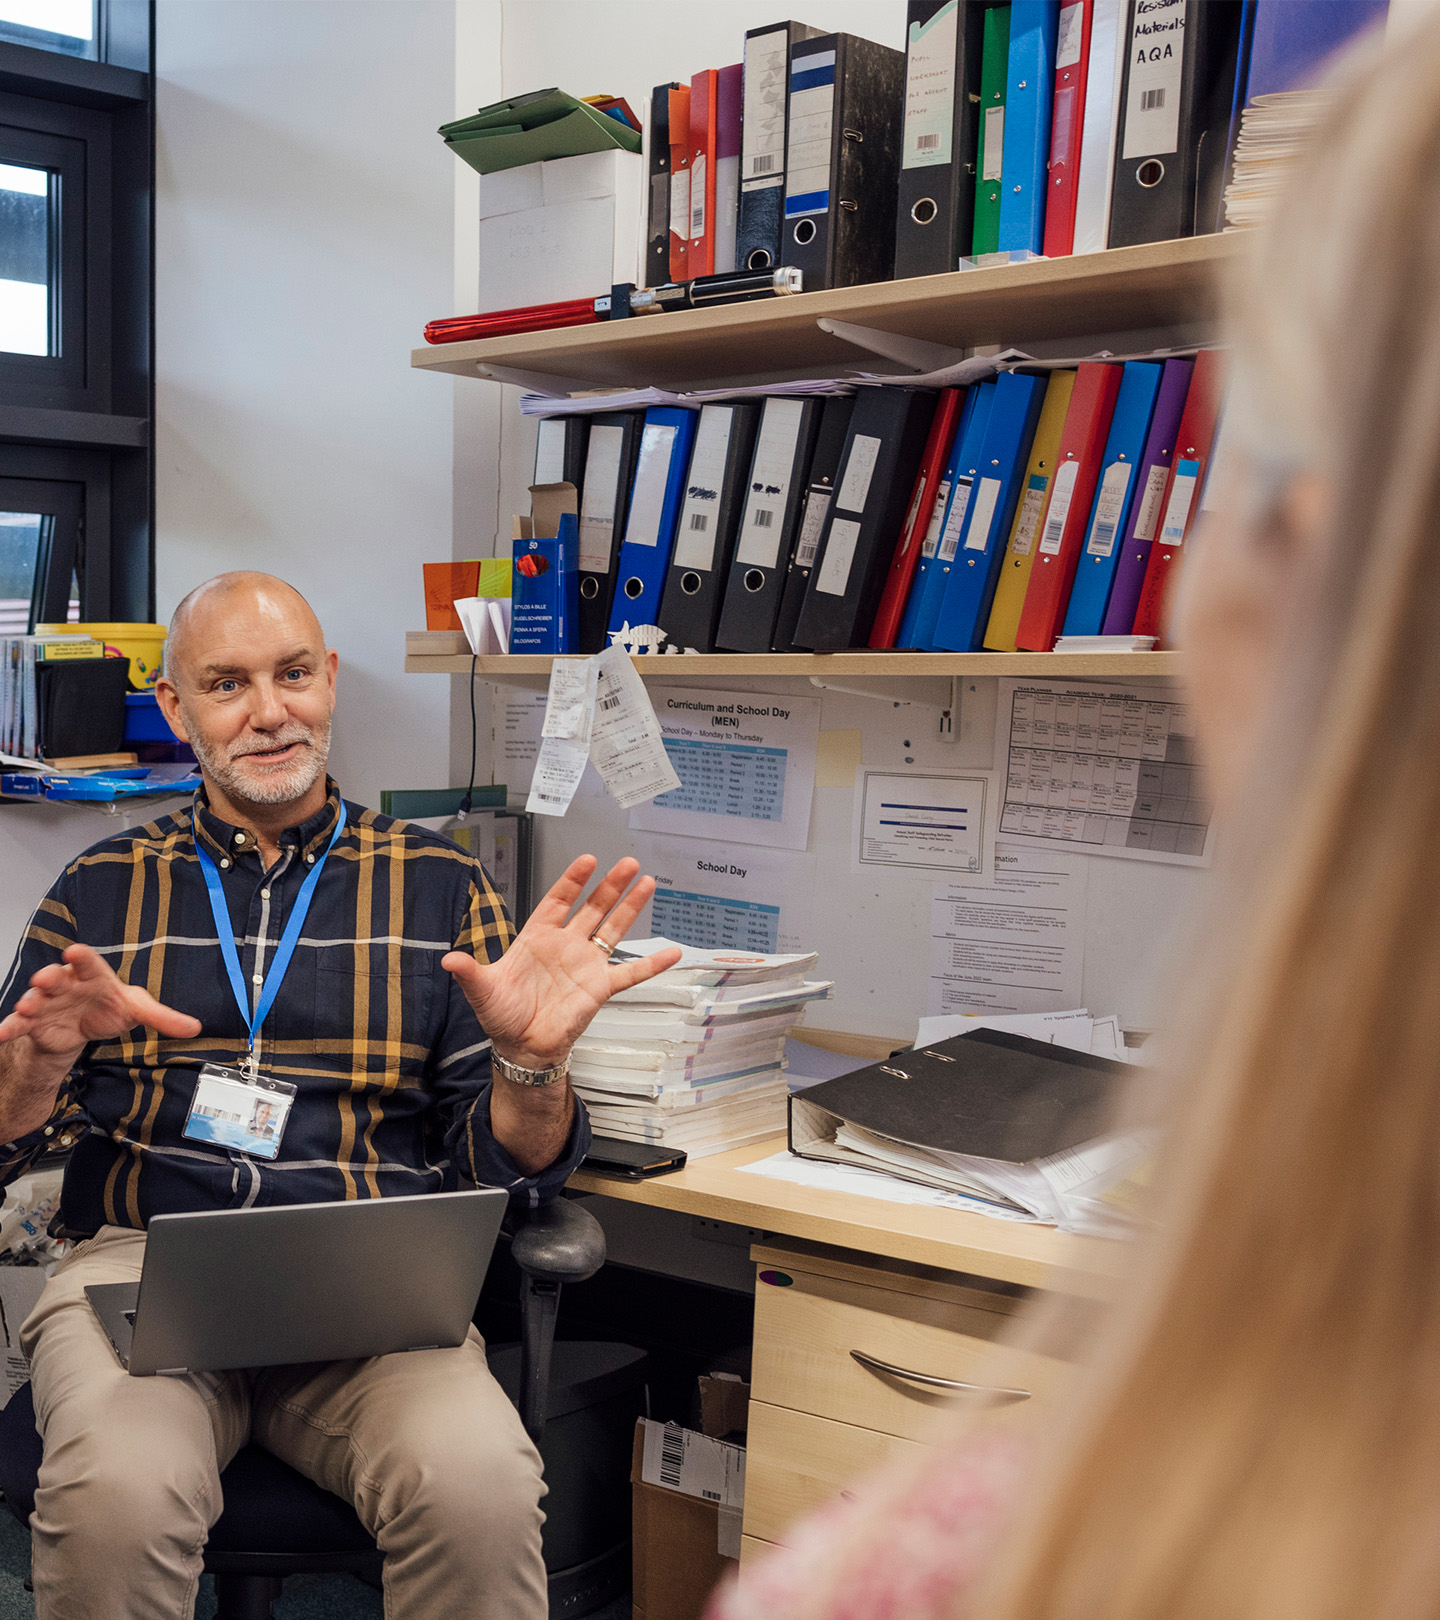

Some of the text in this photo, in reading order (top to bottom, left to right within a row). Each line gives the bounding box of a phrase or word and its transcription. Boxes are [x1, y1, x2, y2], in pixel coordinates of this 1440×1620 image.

[1137, 0, 1183, 14] Resistan
[1135, 18, 1185, 38] Materials
[1137, 43, 1173, 64] AQA
[528, 541, 539, 550] 50
[667, 699, 791, 719] Curriculum and School Day
[711, 716, 740, 728] (MEN)
[661, 725, 680, 735] School
[681, 727, 693, 736] Day
[699, 730, 724, 740] Monday
[725, 732, 732, 740] to
[733, 732, 764, 743] Thursday
[696, 860, 748, 878] School Day
[654, 875, 673, 885] Friday
